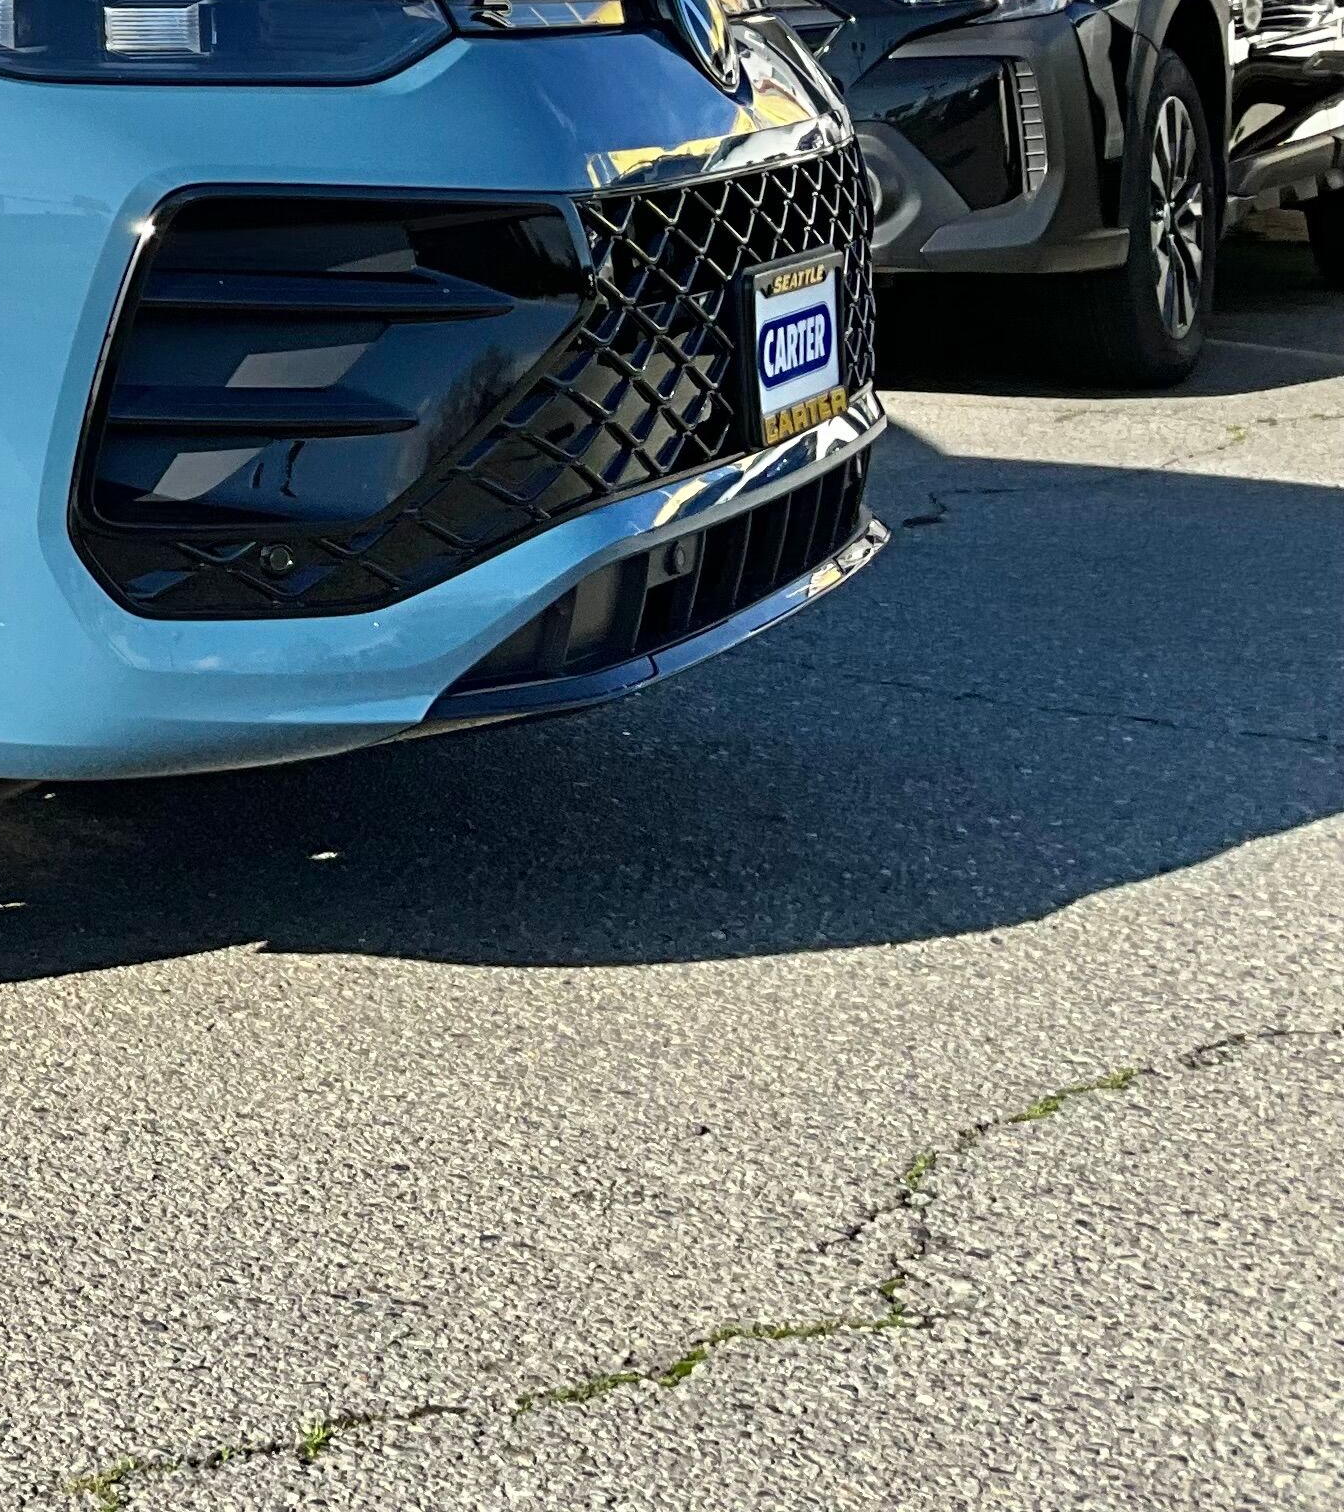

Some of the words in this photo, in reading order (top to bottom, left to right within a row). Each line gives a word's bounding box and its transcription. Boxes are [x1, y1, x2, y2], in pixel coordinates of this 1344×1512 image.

[772, 264, 825, 294] SEATTLE
[763, 313, 826, 378] CARTER
[765, 391, 848, 443] CARTER
